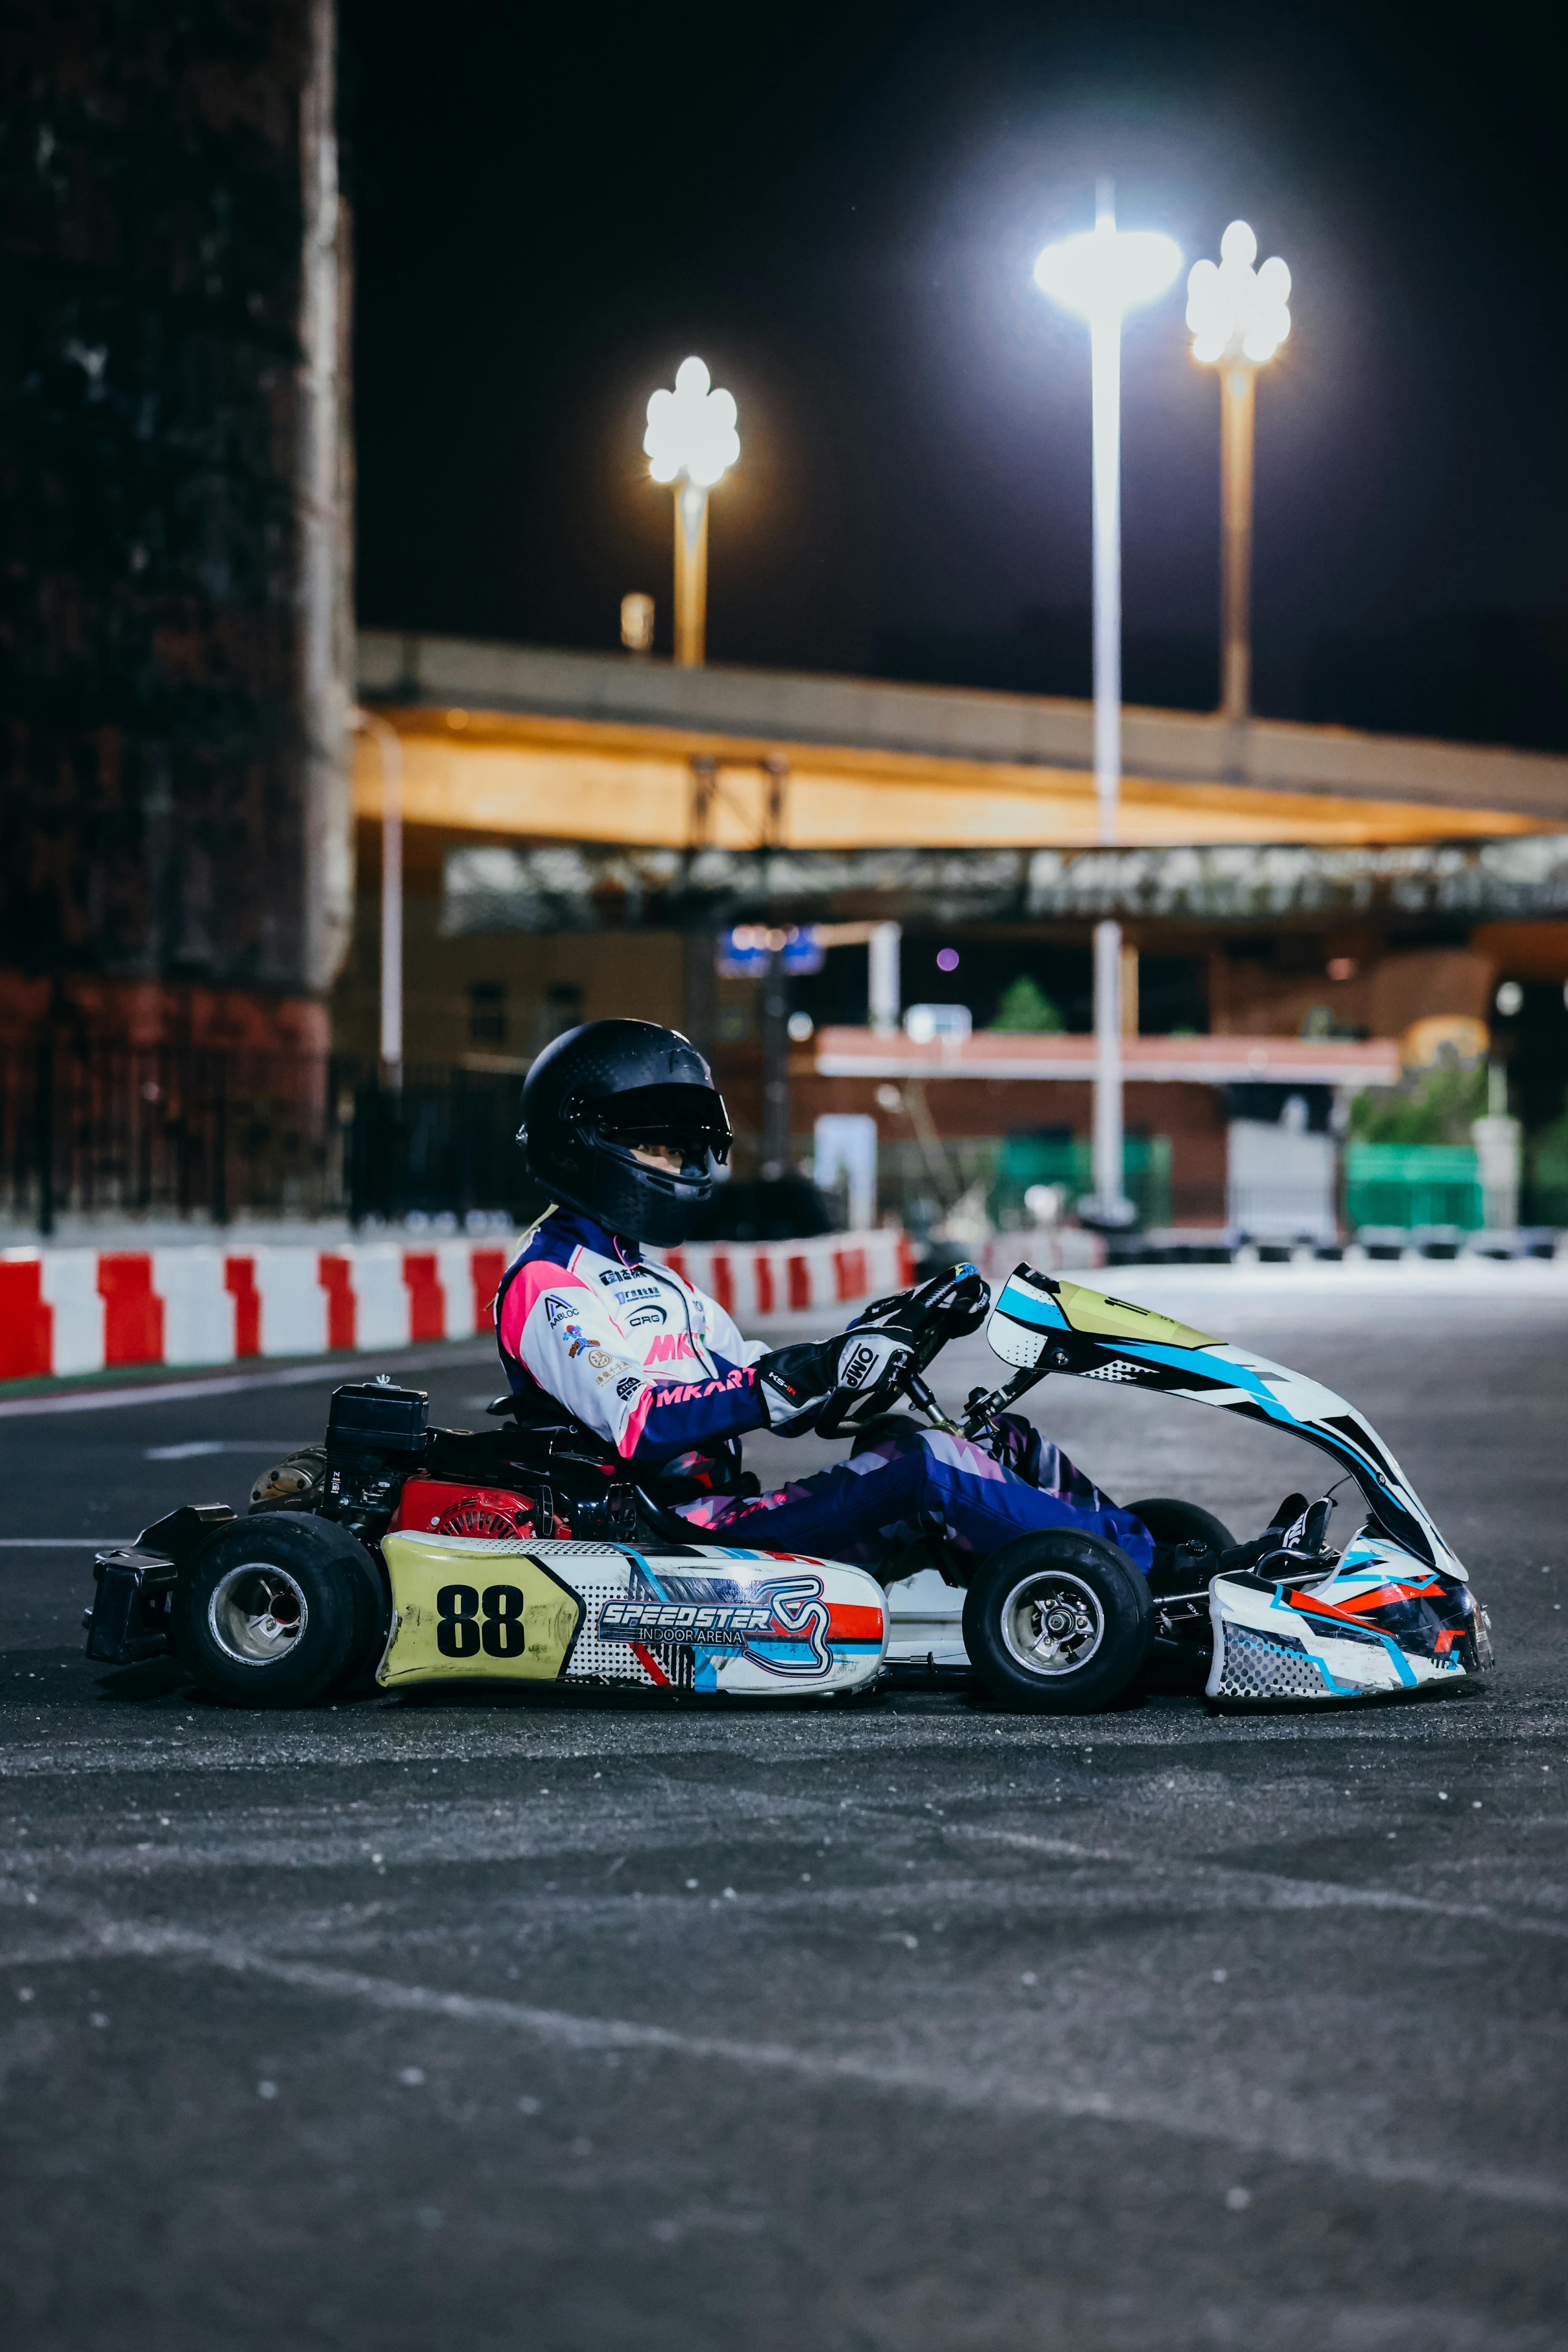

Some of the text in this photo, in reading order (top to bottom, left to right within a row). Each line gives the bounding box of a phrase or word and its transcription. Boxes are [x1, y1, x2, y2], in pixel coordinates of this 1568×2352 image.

[550, 1309, 579, 1330] AABLOC
[630, 1315, 660, 1326] CRG
[846, 1348, 873, 1387] OMP
[618, 1380, 637, 1393] XTECA
[657, 1367, 757, 1407] MKART
[769, 1372, 797, 1396] KS-1R
[437, 1584, 525, 1658] 88
[603, 1604, 772, 1629] SPEEDSTER
[639, 1628, 742, 1643] INDOOR ARENA
